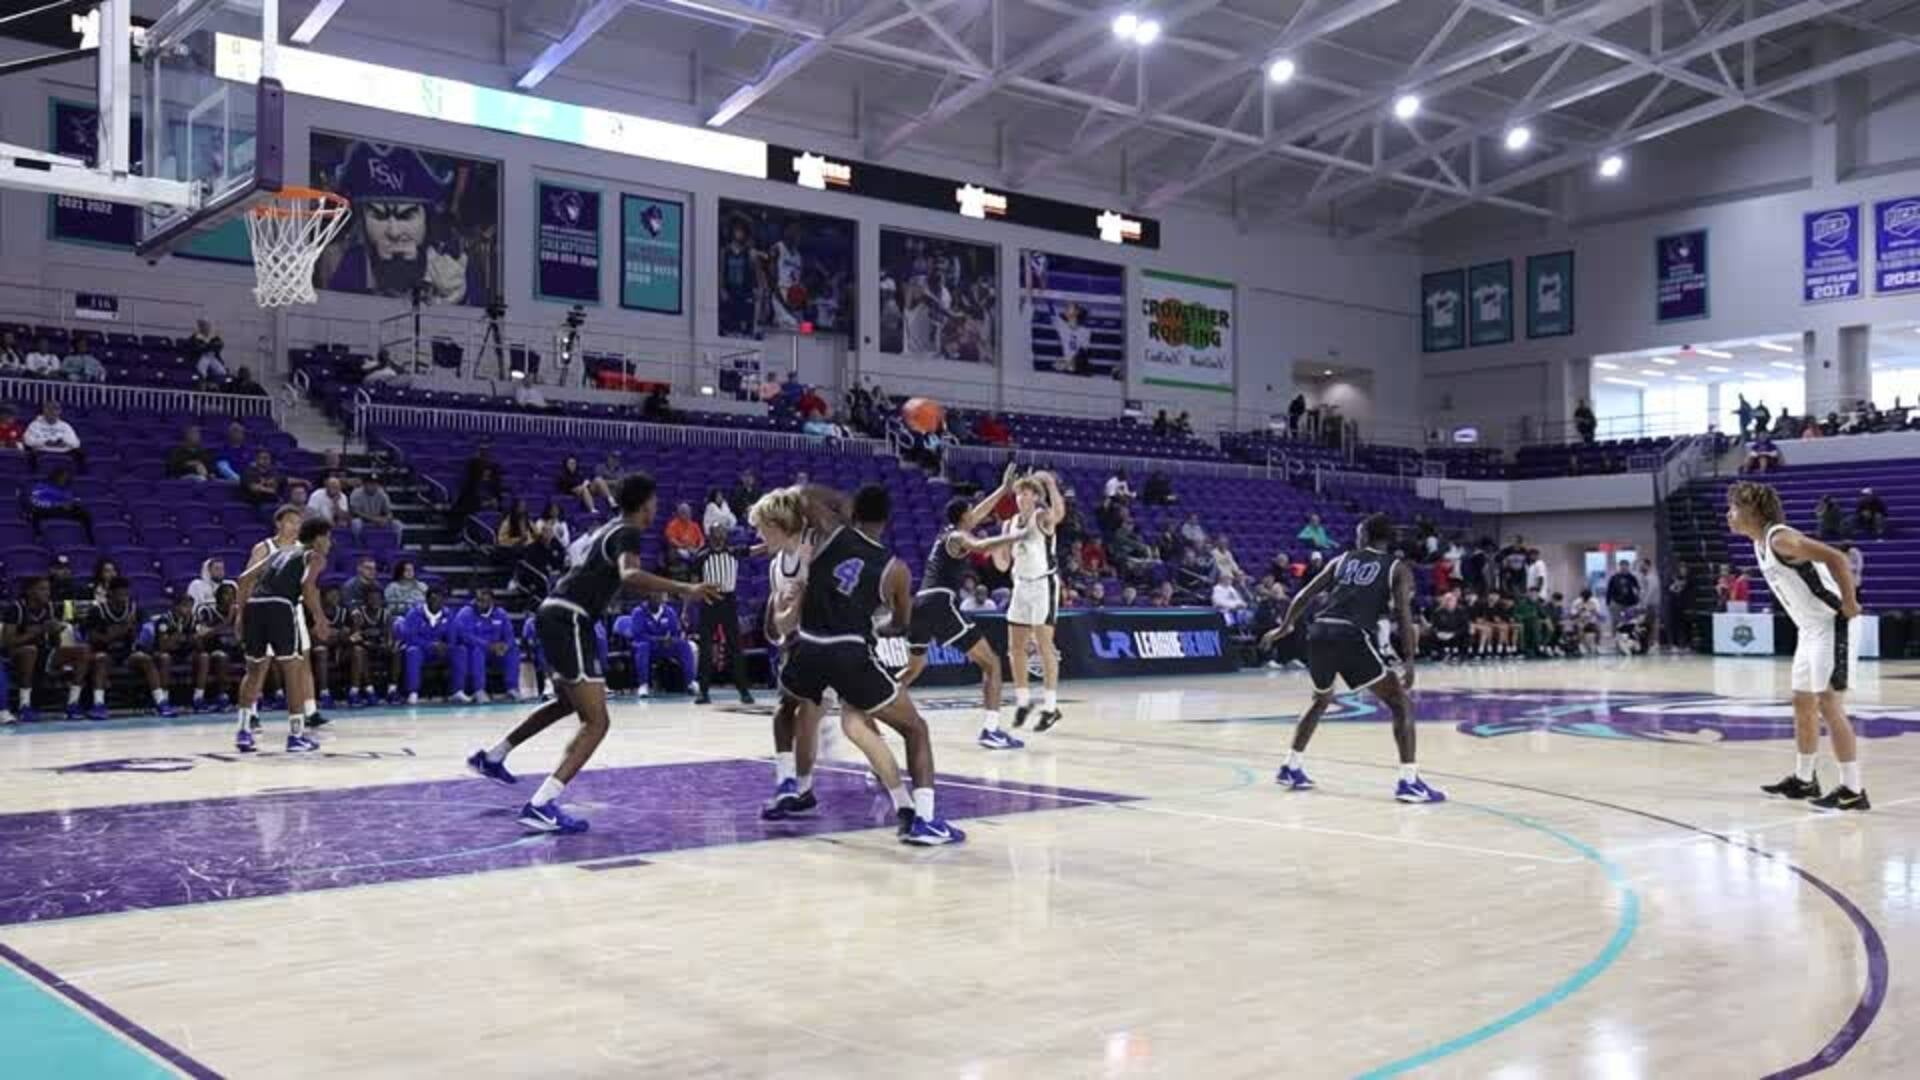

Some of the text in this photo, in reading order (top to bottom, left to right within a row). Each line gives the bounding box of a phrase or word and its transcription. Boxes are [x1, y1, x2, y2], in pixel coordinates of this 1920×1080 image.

[368, 158, 405, 192] FSW
[1812, 281, 1851, 299] 2017
[1142, 298, 1230, 329] CROWTHER
[1148, 322, 1222, 348] ROOFING
[833, 557, 865, 597] 4
[1343, 558, 1381, 586] 10
